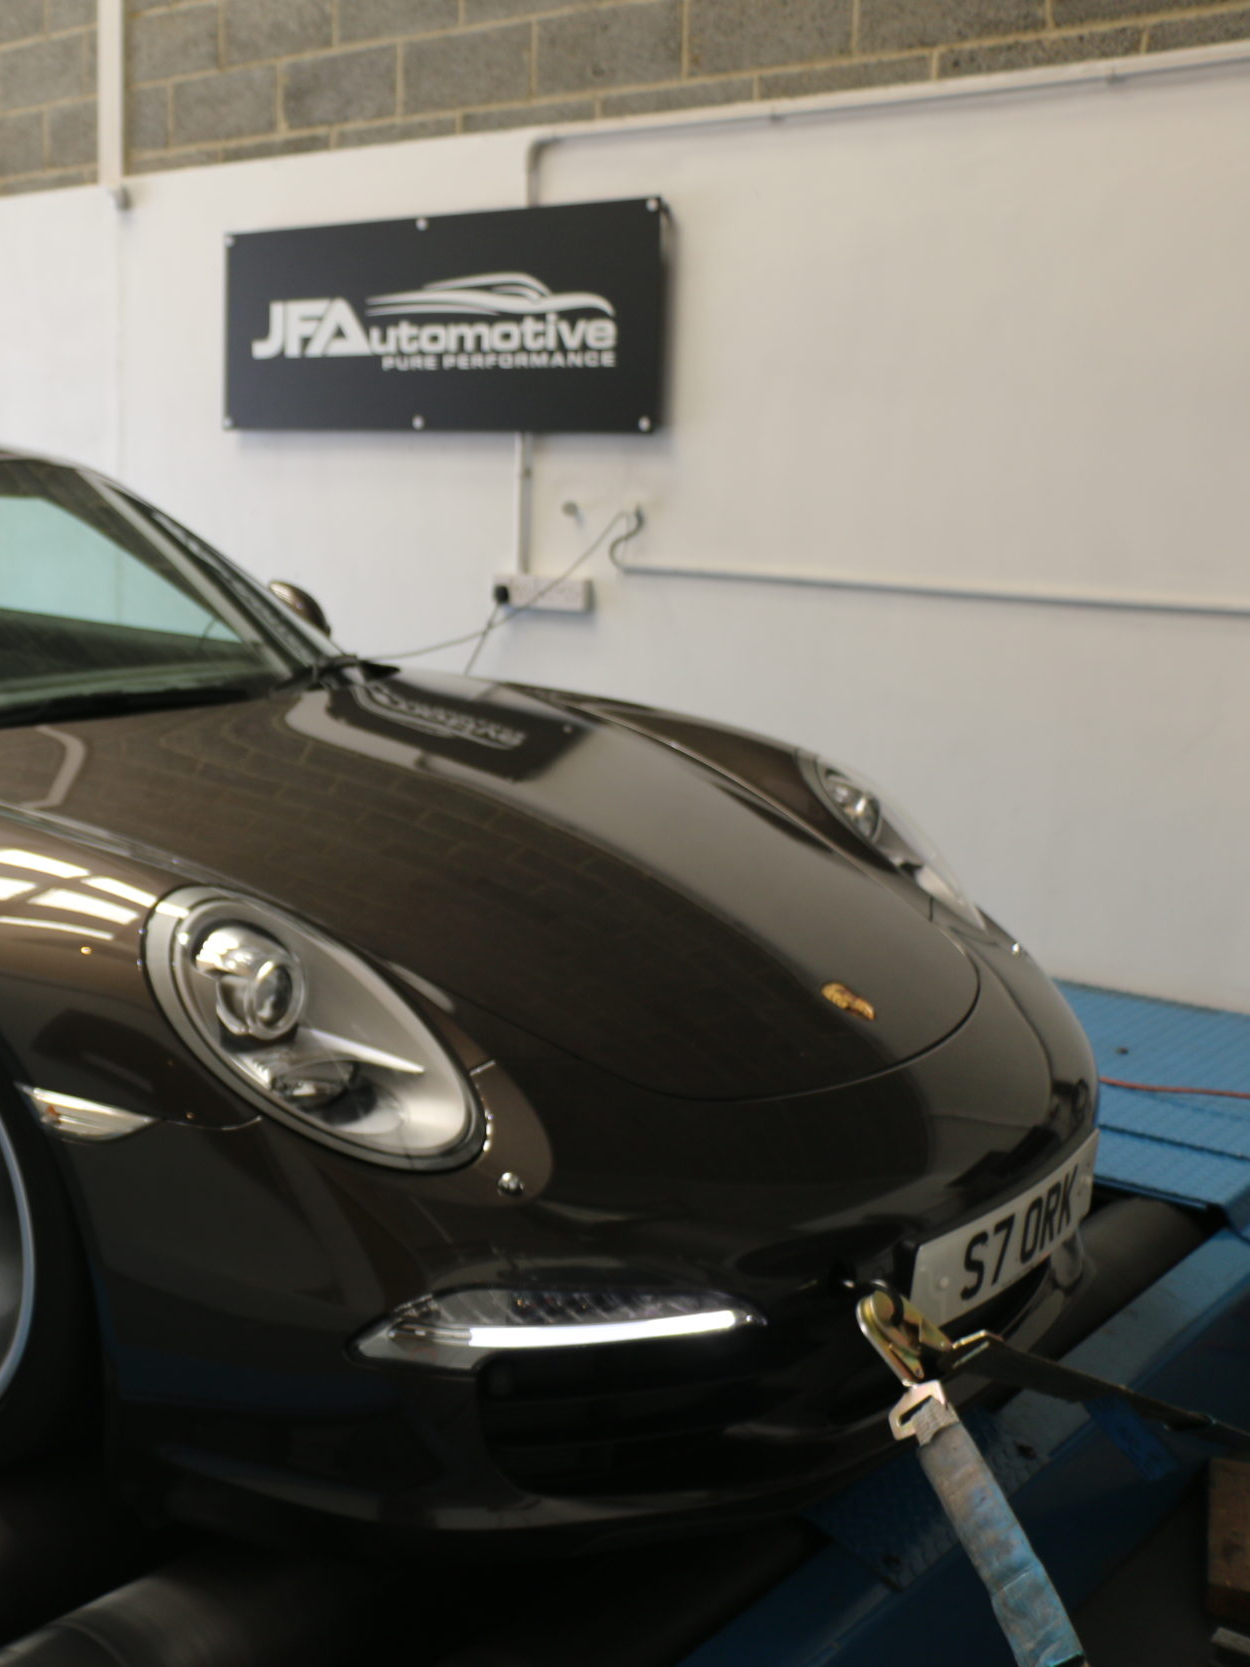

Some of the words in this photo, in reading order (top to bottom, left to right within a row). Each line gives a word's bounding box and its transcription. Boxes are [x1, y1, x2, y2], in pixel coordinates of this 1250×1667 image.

[382, 354, 438, 372] PURE
[442, 350, 616, 371] PERFORMANCE
[960, 1215, 1015, 1302] S7
[1019, 1163, 1079, 1266] ORK
